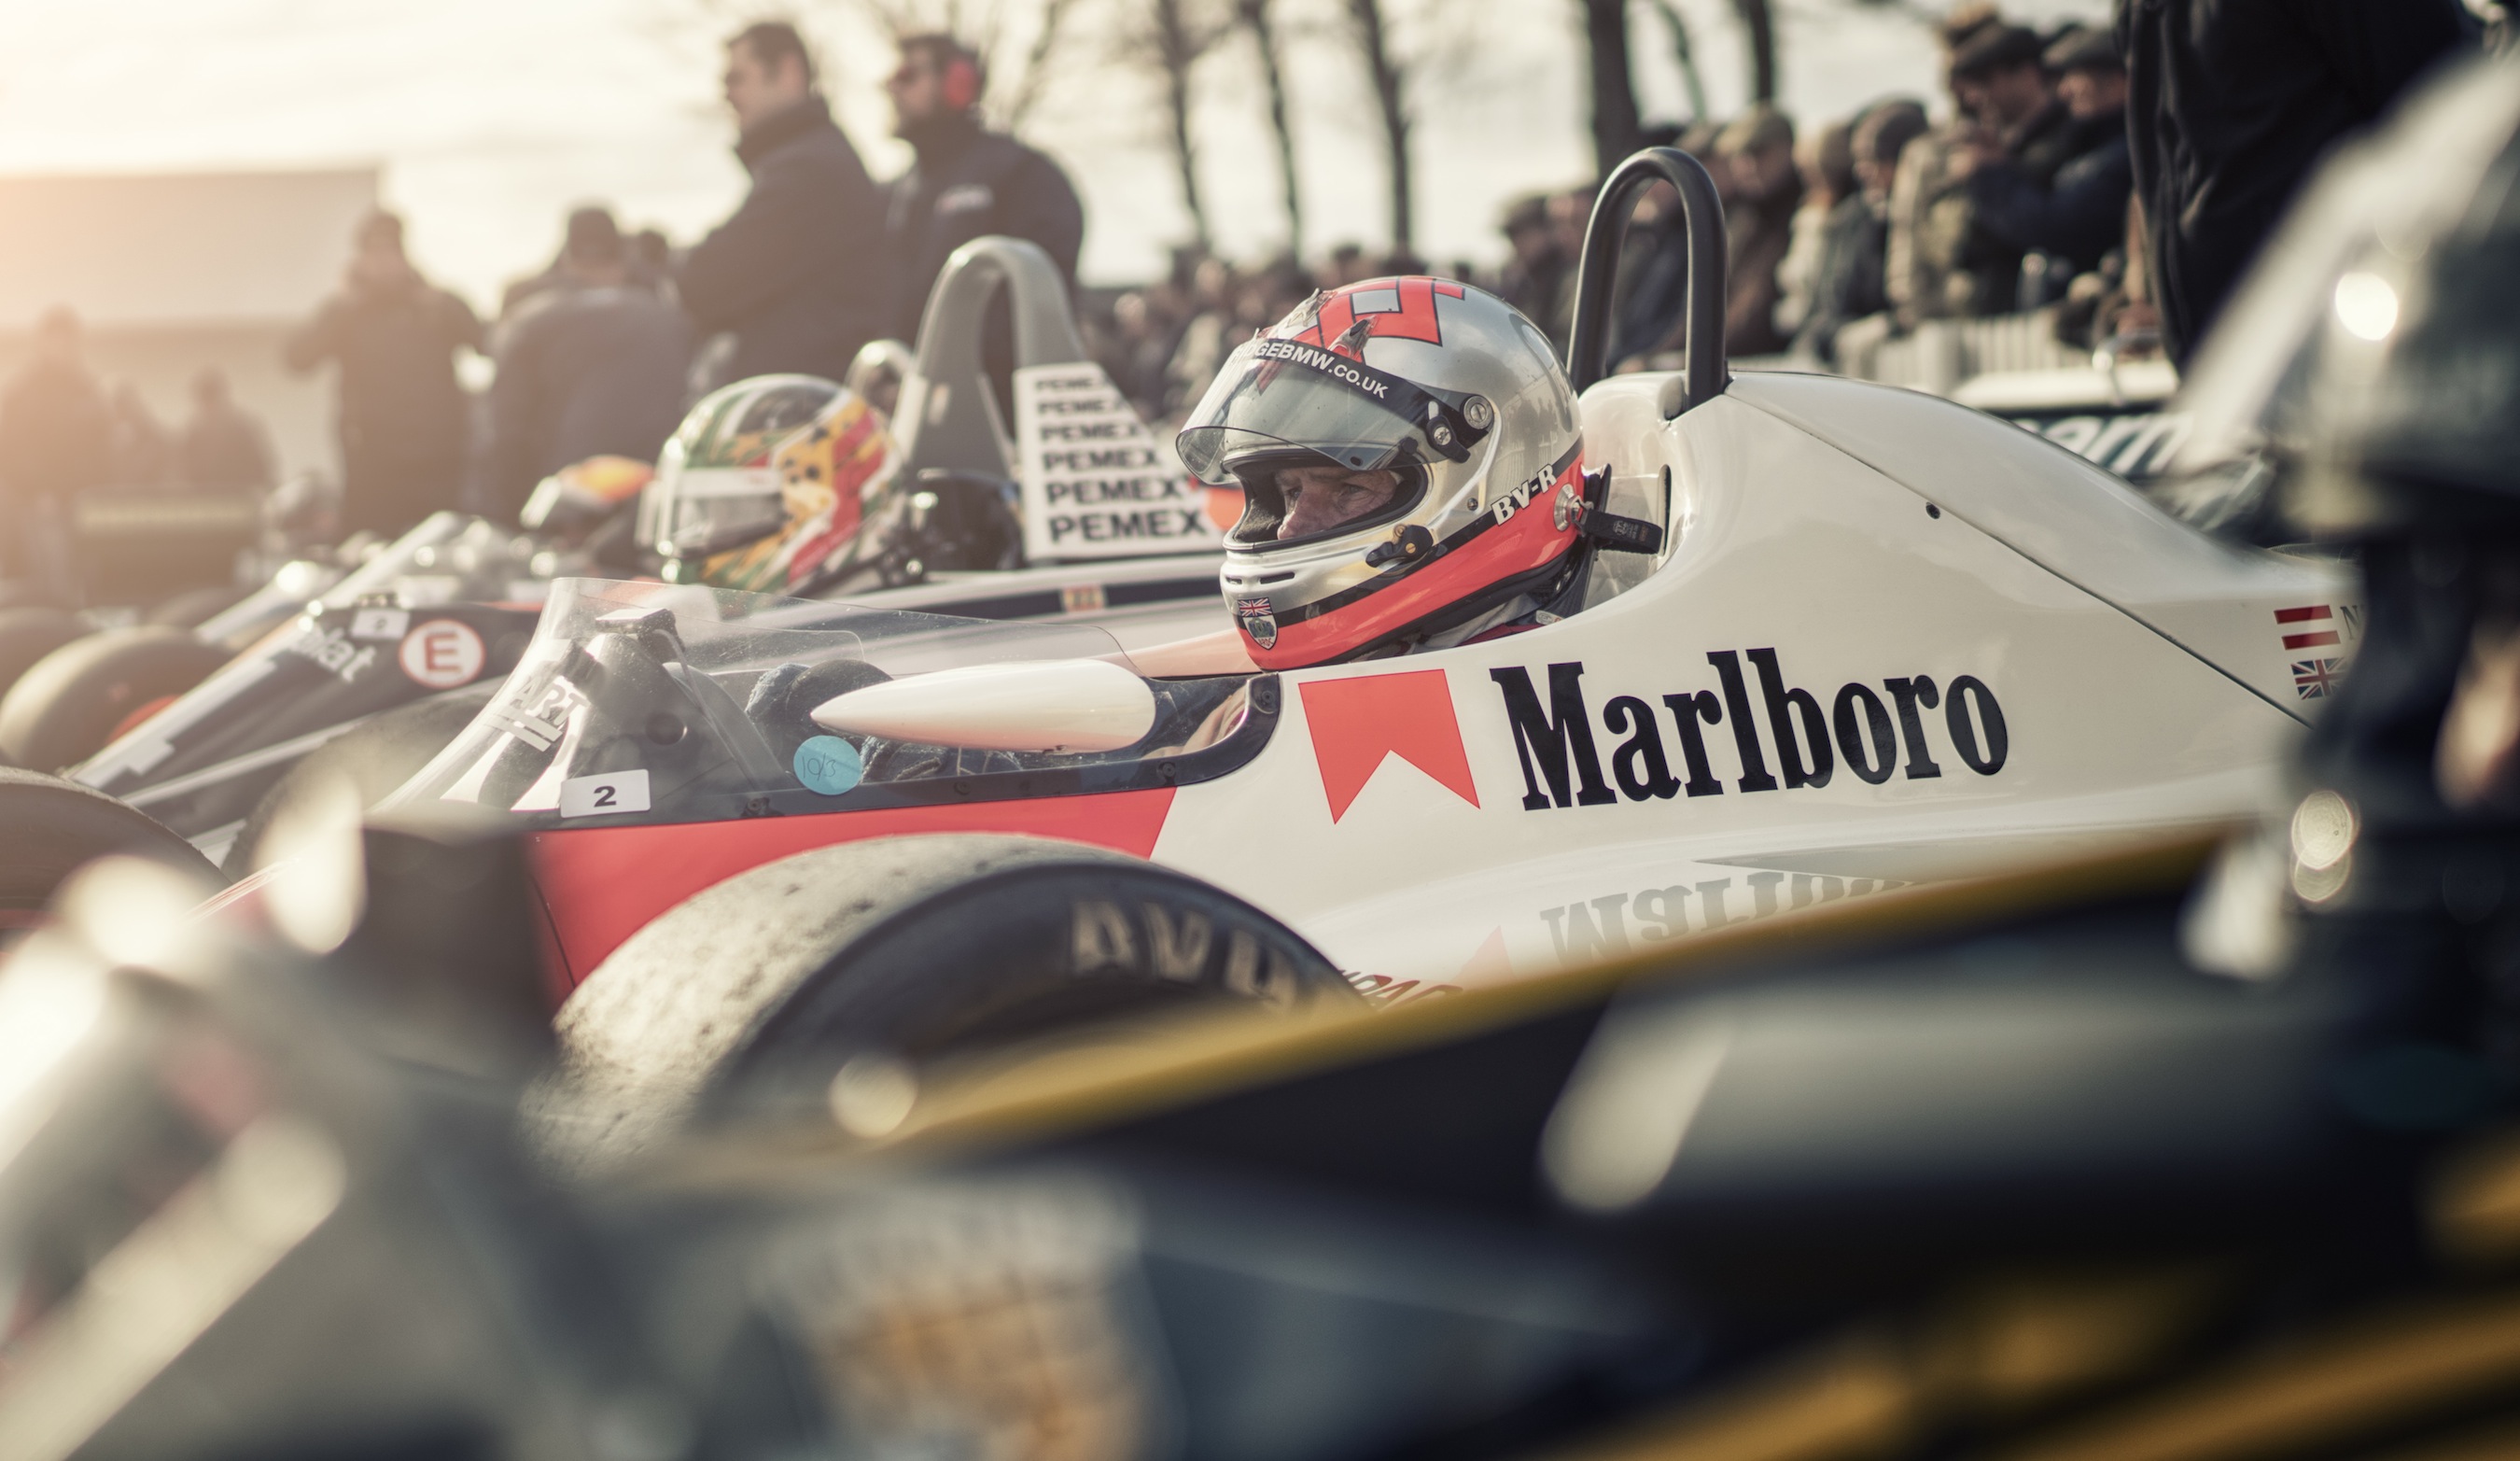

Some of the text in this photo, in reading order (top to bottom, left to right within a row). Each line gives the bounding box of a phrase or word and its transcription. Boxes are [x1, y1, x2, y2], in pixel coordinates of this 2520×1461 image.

[1043, 447, 1161, 471] PEMEX
[1046, 478, 1183, 504] PEMEX
[1491, 464, 1559, 526] BV-R
[1049, 510, 1207, 544] PEMEX
[424, 632, 464, 674] E
[1489, 647, 2009, 811] Marlboro
[593, 784, 618, 808] 2
